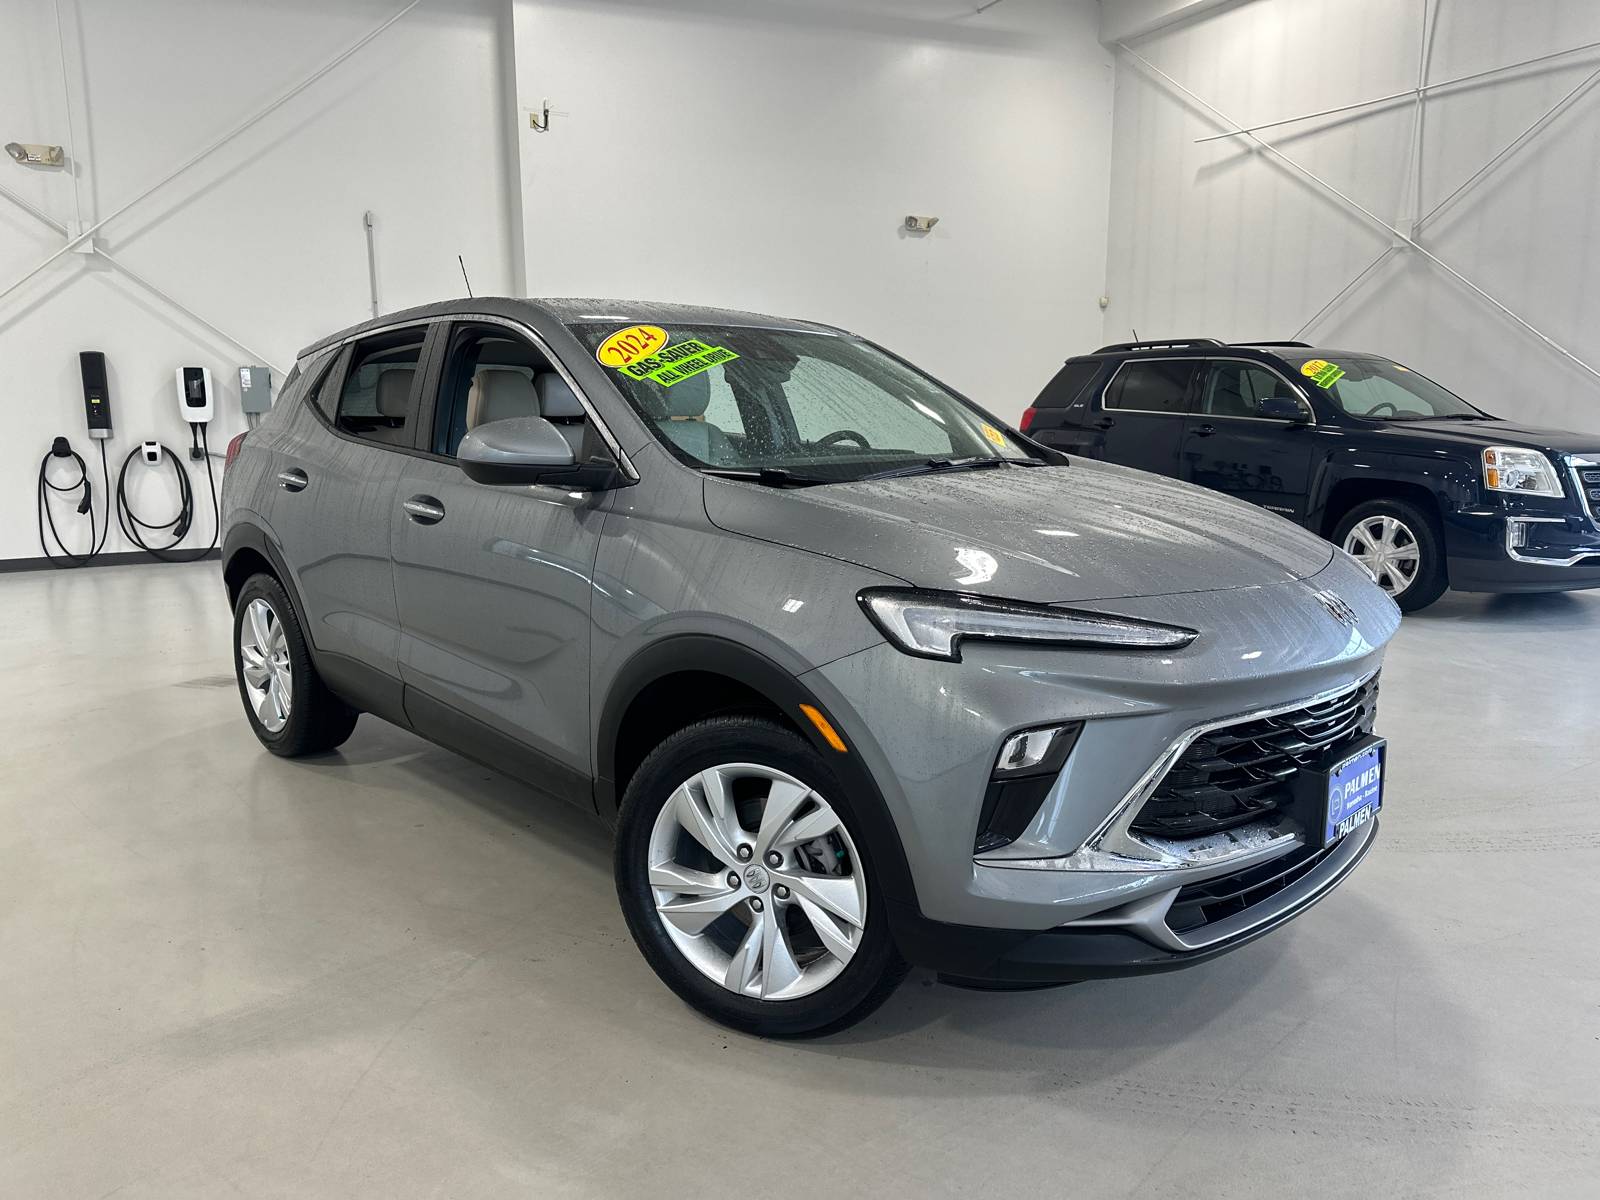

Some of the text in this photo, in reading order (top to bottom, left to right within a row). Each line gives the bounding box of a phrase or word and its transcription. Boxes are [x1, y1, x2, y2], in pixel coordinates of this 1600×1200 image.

[607, 327, 658, 364] 2024
[626, 342, 705, 377] GAS-SAVER
[656, 349, 733, 384] ALL WHEEL DRIVE
[1306, 361, 1324, 375] 2017
[1344, 763, 1381, 800] PALMEN
[1338, 805, 1372, 840] PALMEN
